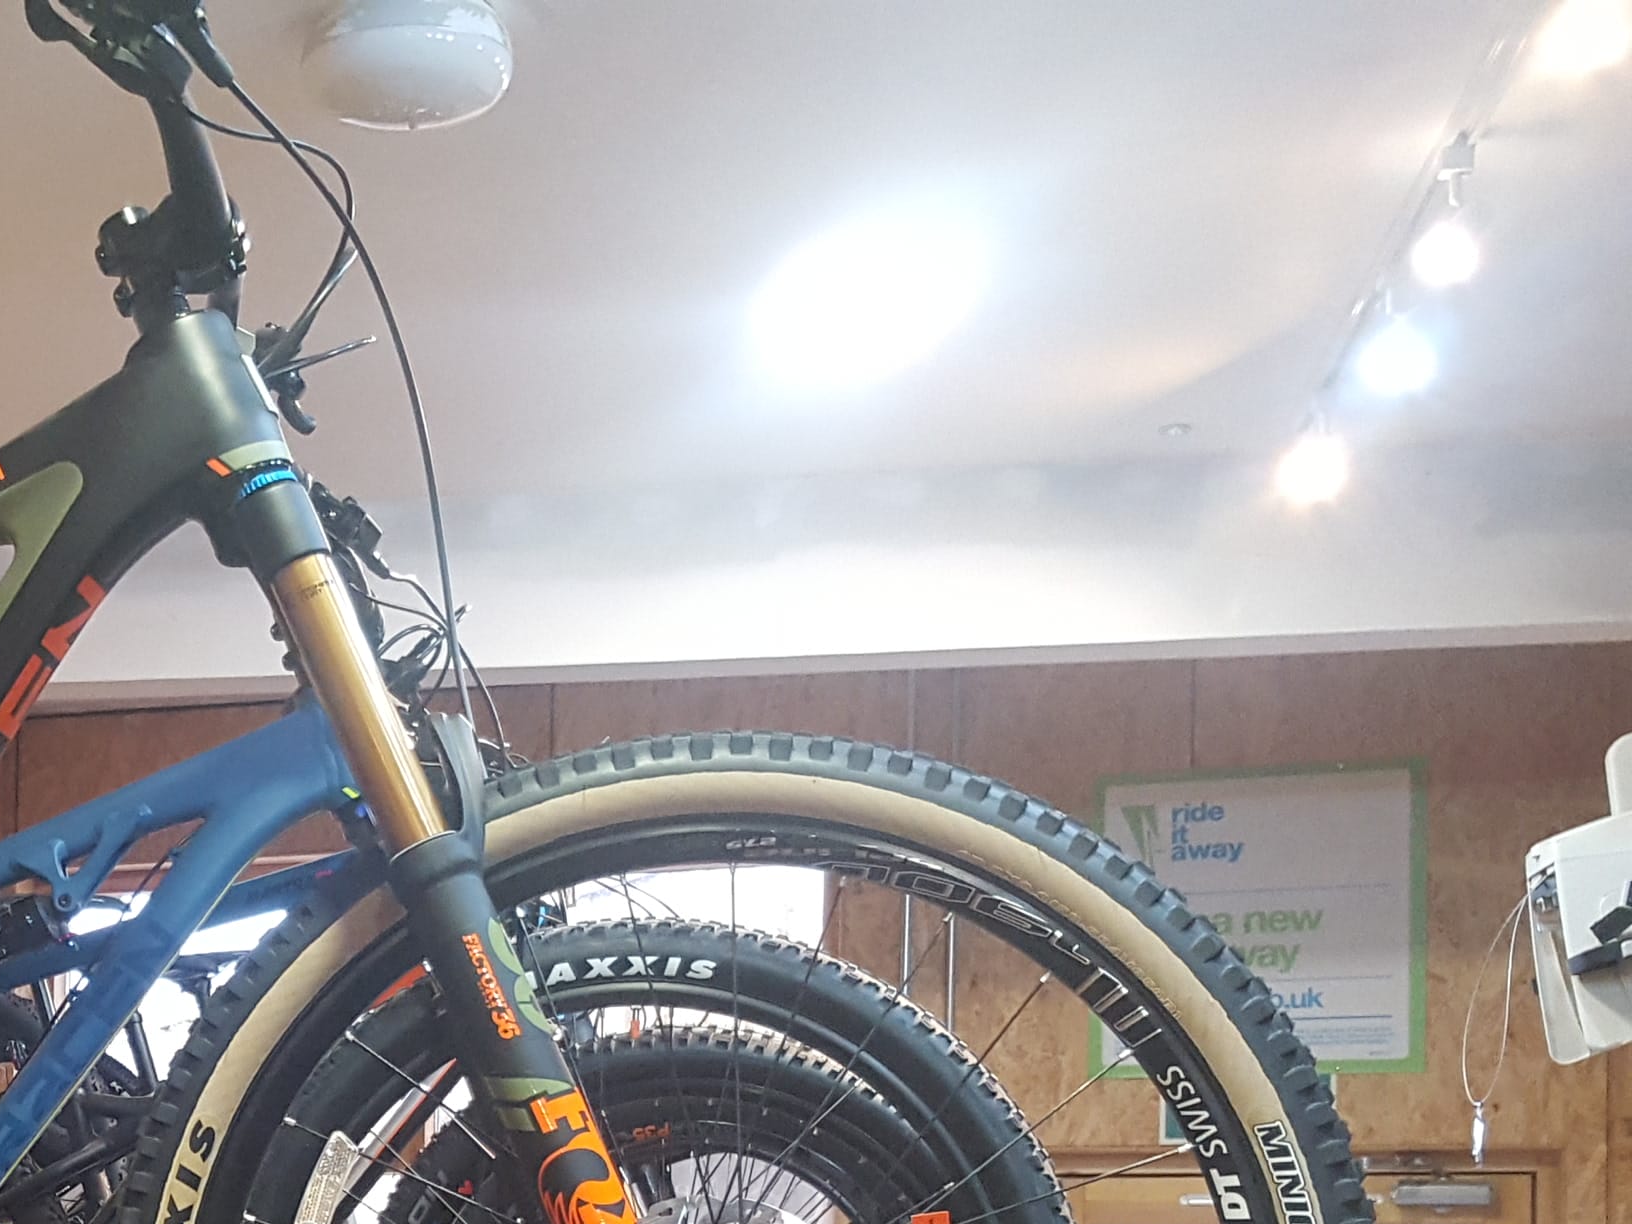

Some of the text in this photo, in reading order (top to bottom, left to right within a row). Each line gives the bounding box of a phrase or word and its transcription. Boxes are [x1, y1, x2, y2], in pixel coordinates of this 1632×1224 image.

[1172, 802, 1224, 824] ride
[1172, 825, 1188, 843] it
[1172, 841, 1244, 863] away
[1244, 909, 1323, 932] new
[1269, 987, 1324, 1010] o.uk
[1156, 1066, 1251, 1221] DT SWISS
